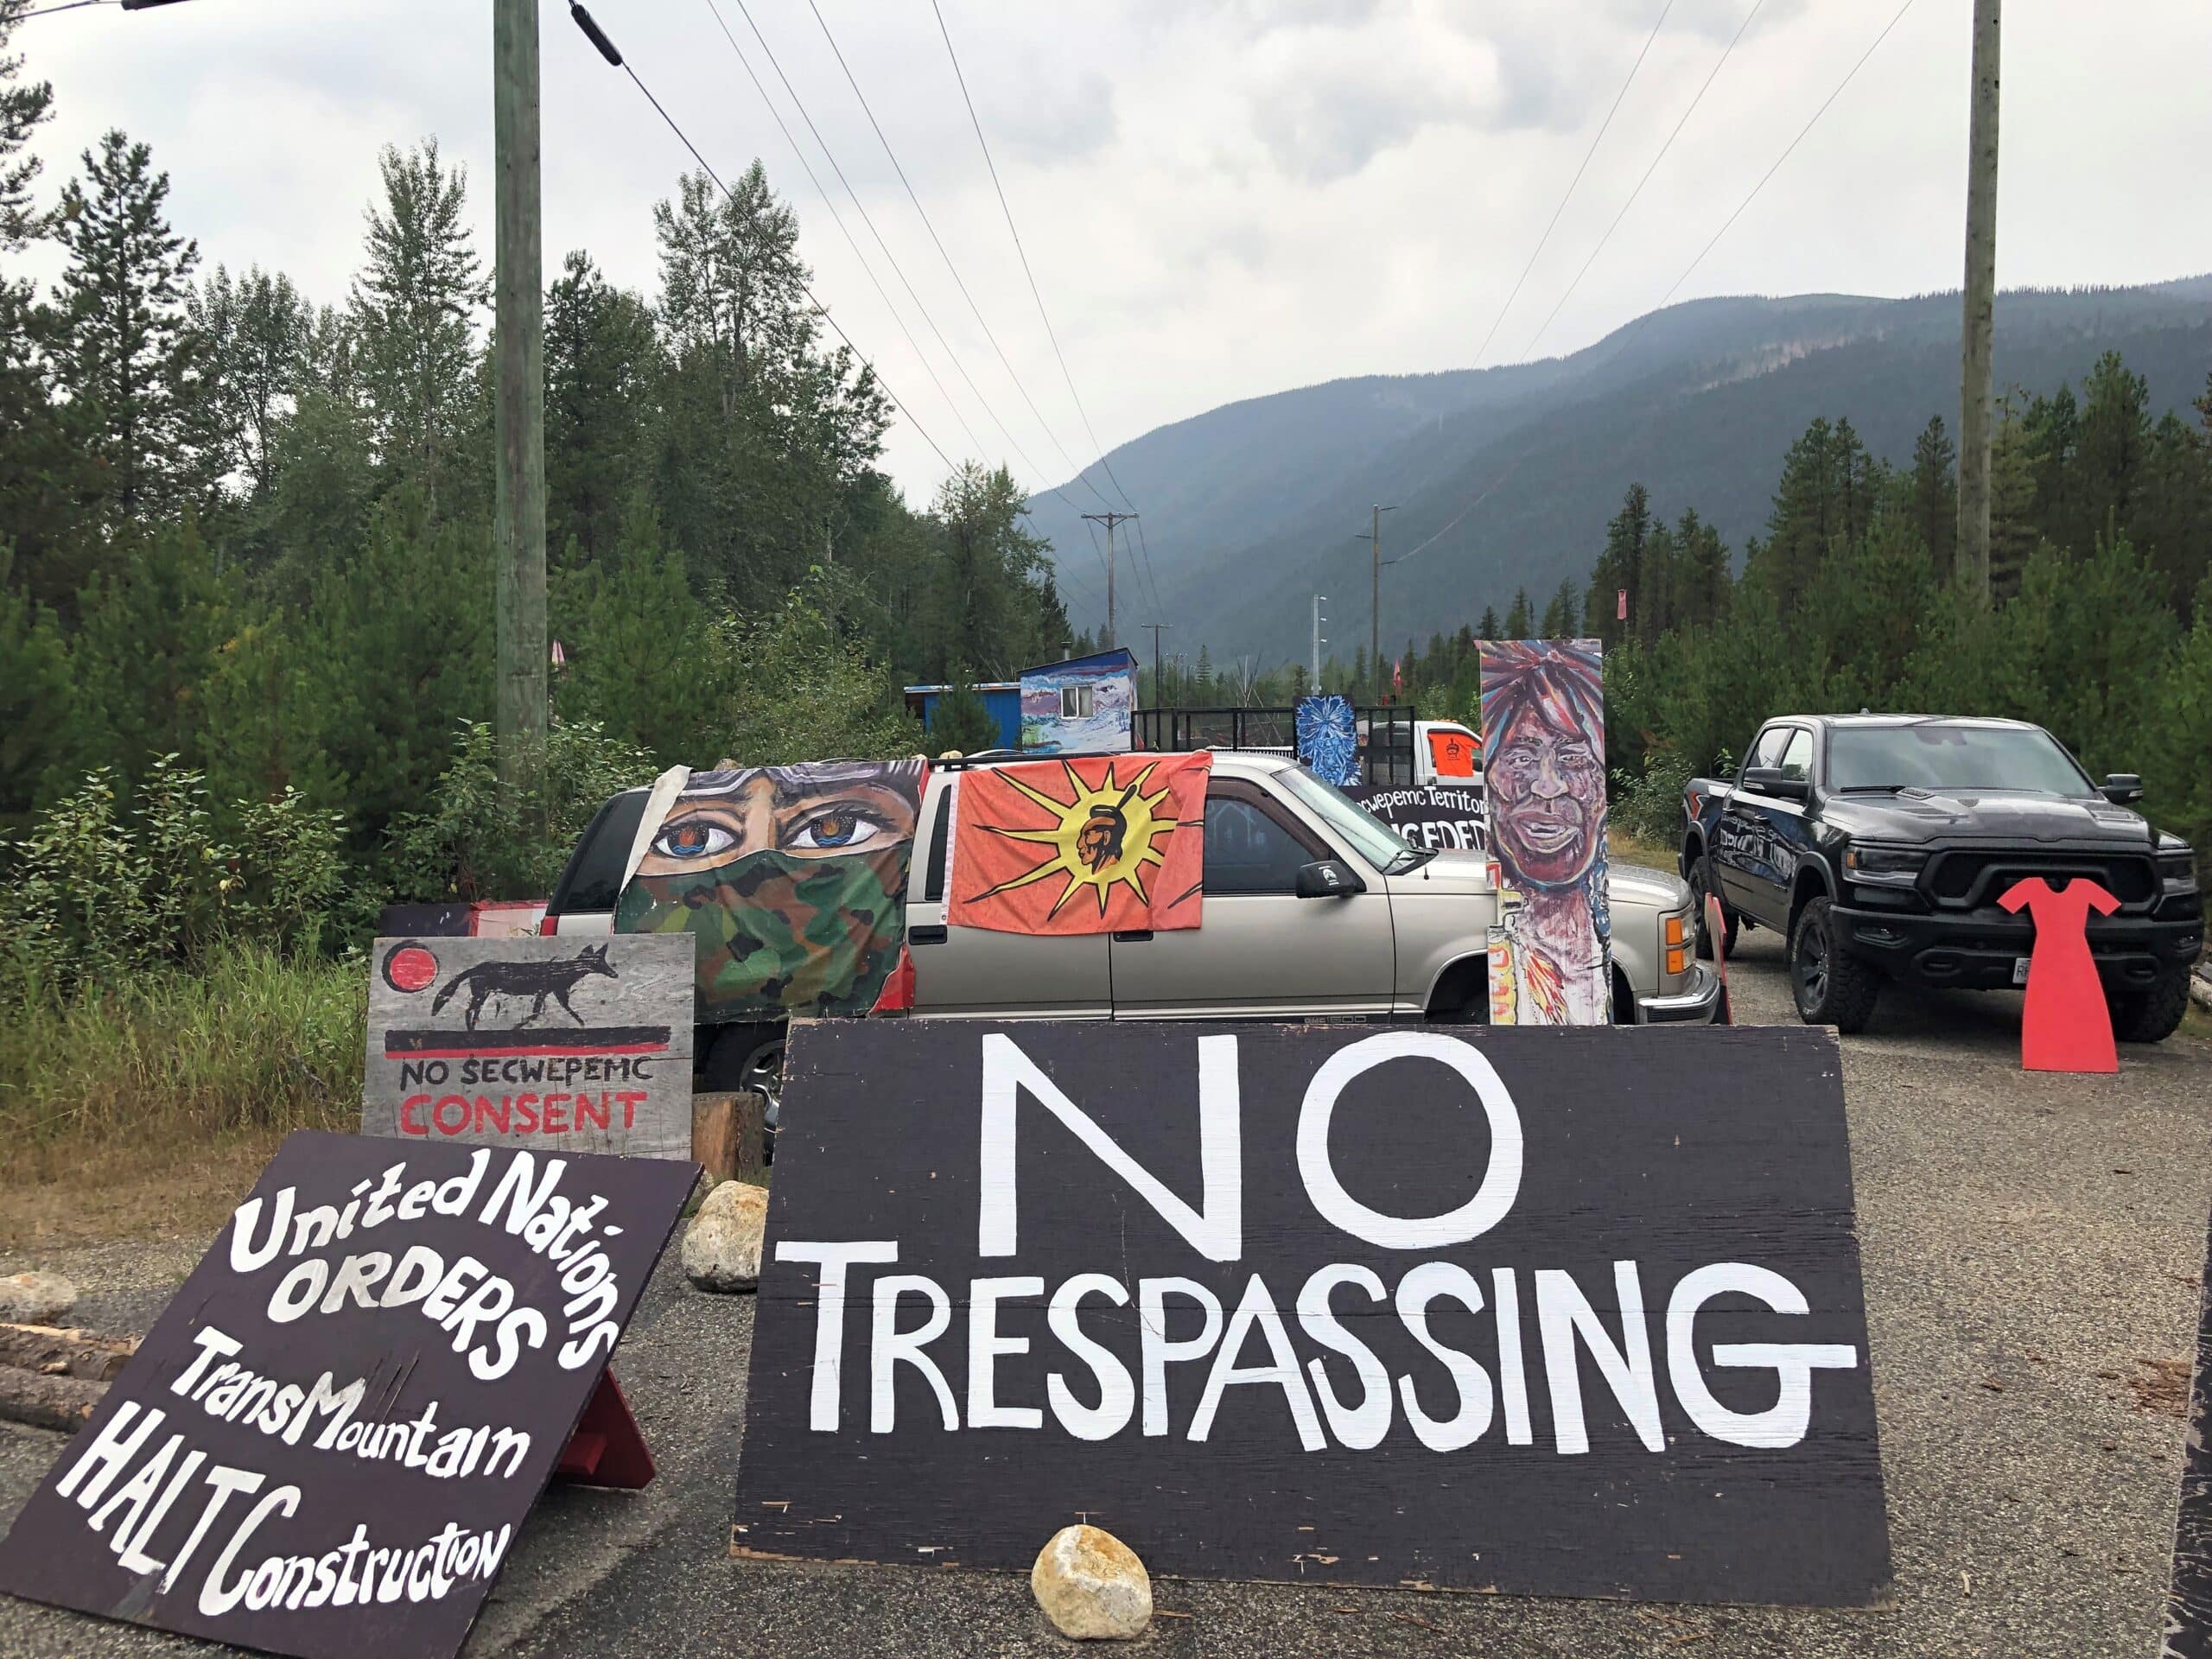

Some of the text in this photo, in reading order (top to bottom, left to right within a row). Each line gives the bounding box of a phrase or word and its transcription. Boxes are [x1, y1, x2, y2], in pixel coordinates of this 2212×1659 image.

[1357, 785, 1485, 819] cwepemc Territor
[399, 1055, 654, 1092] NO SECWEPEMC
[399, 1090, 648, 1136] CONSENT
[978, 1030, 1524, 1262] NO
[230, 1150, 624, 1370] United Nations
[267, 1245, 548, 1381] ORDERS
[55, 1400, 266, 1595] HALT
